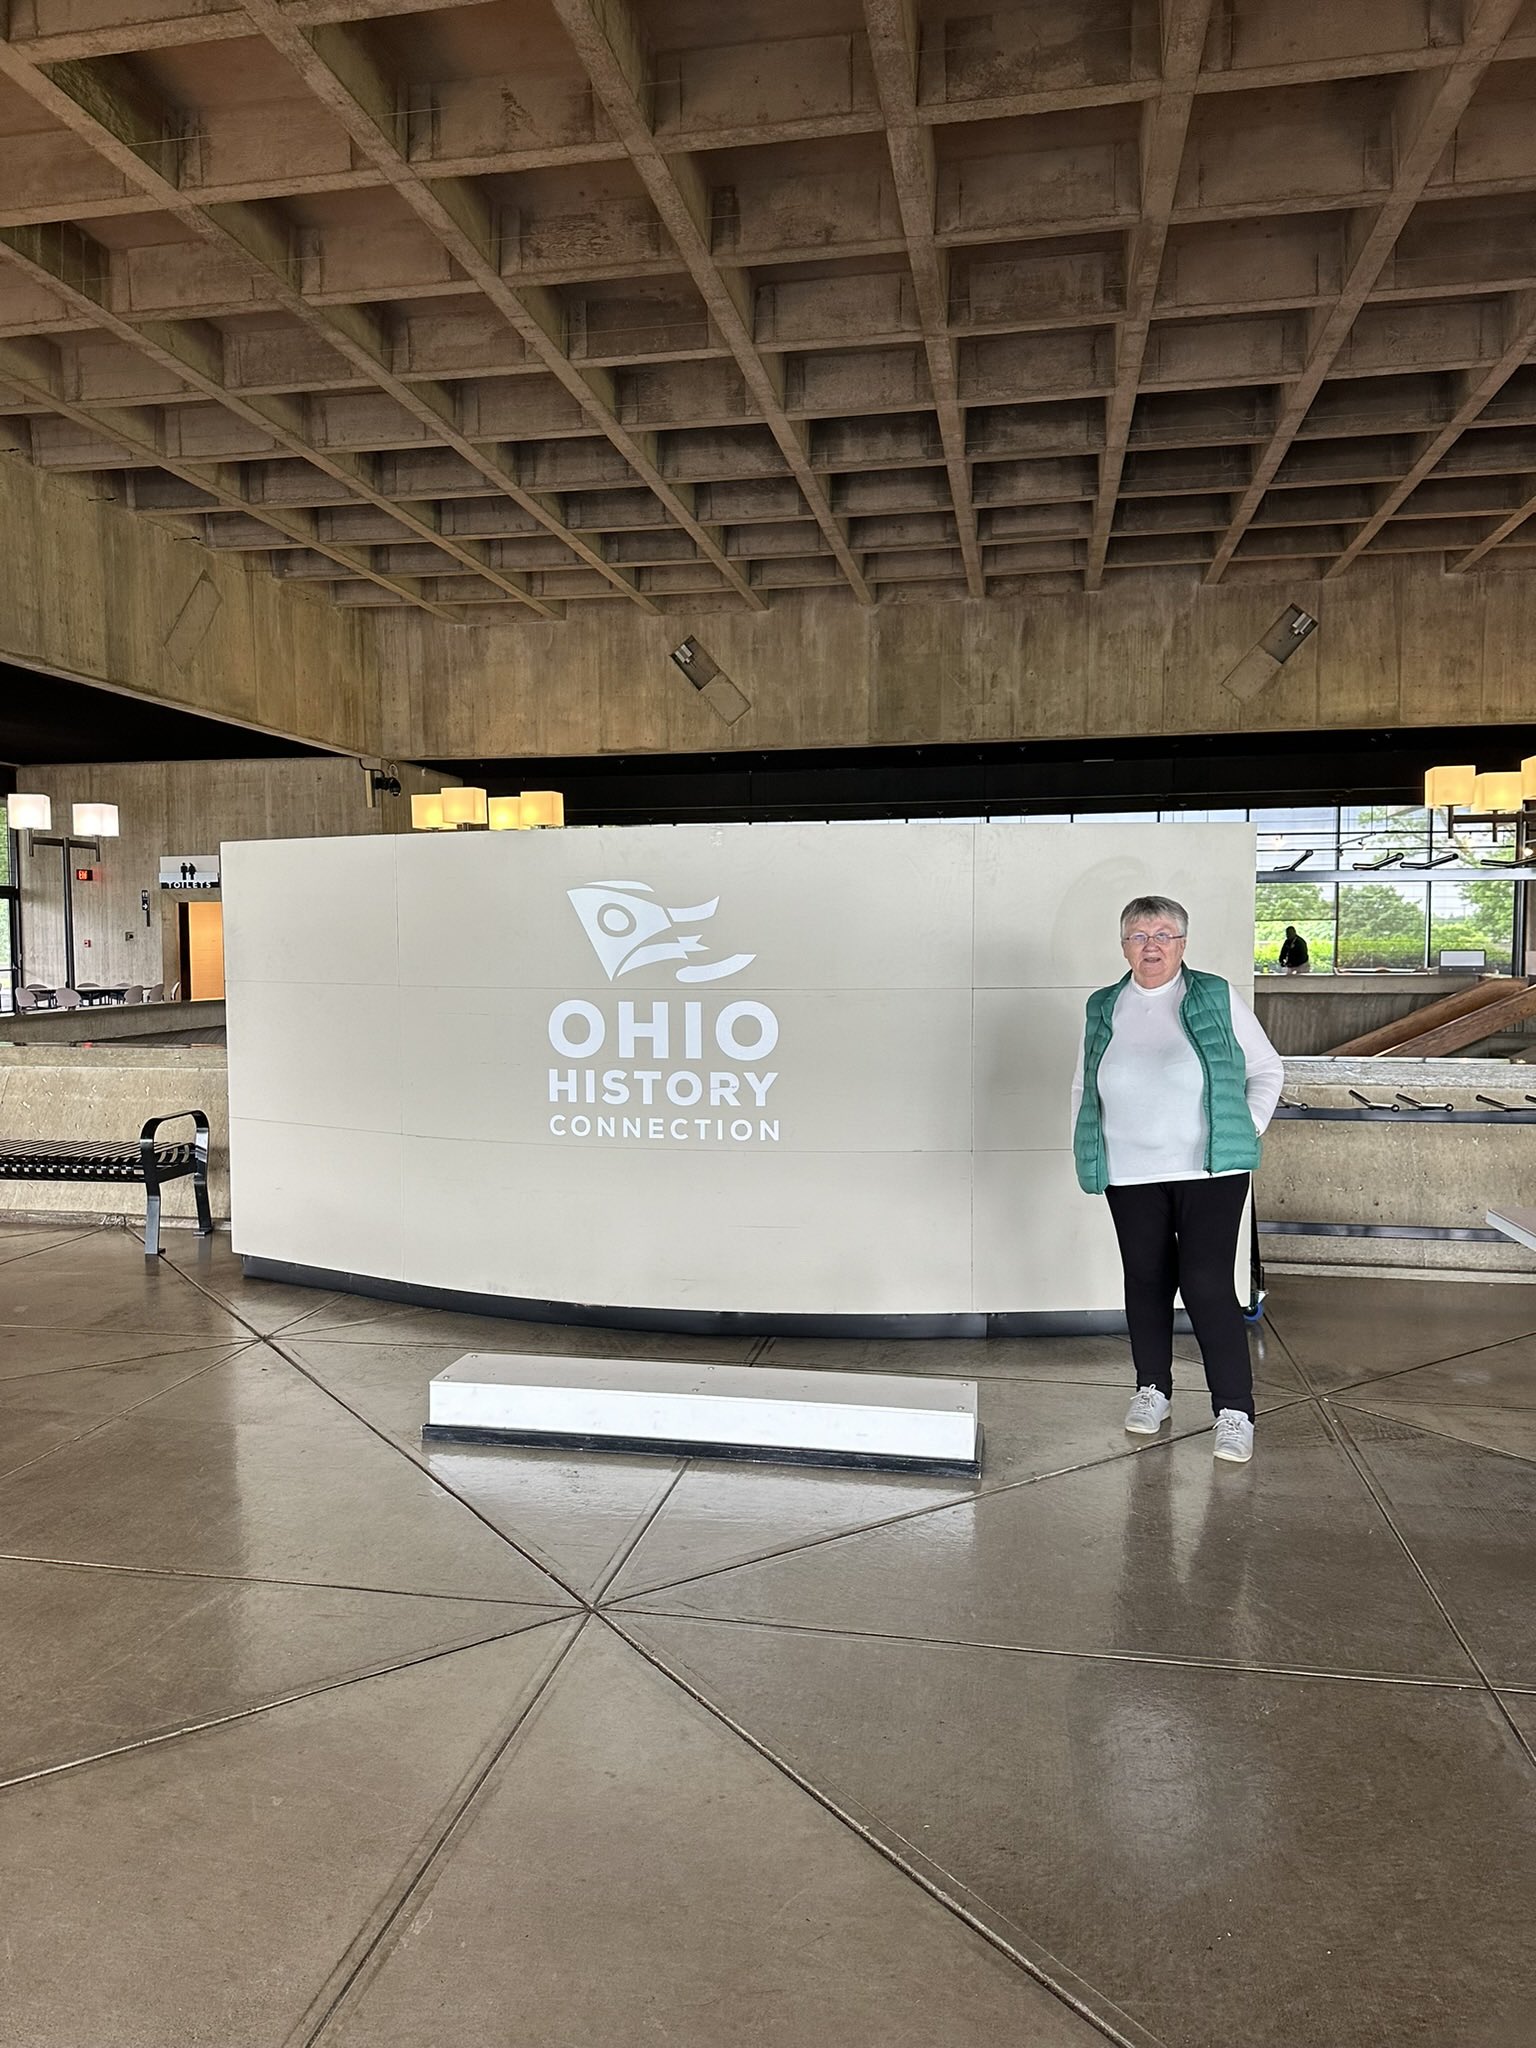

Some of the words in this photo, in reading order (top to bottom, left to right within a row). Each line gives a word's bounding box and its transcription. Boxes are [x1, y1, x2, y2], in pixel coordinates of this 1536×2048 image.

[168, 880, 212, 889] TOILETS
[548, 999, 780, 1062] OHIO
[548, 1068, 780, 1107] HISTORY
[548, 1114, 780, 1142] CONNECTION
